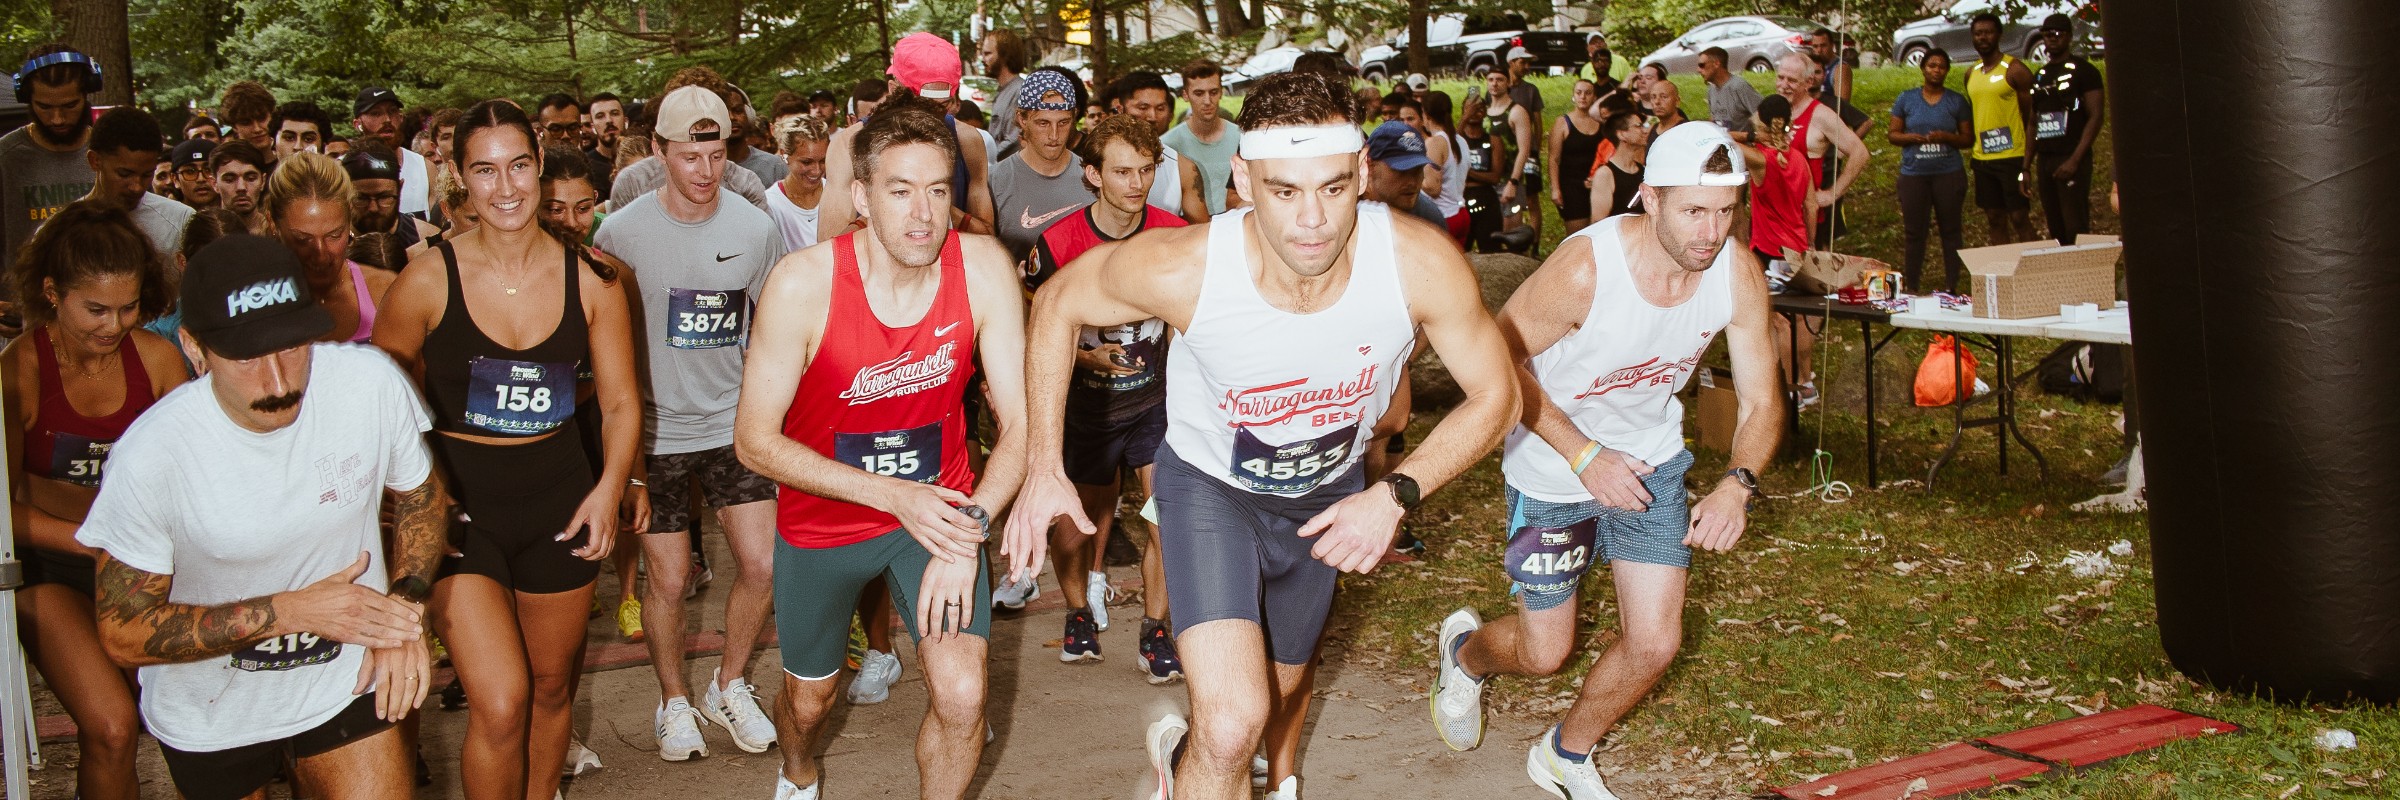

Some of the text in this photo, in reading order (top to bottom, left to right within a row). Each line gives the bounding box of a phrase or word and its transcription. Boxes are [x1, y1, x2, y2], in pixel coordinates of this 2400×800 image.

[227, 280, 298, 317] HOKA
[678, 312, 737, 333] 3874
[839, 341, 956, 406] Narragansett
[896, 375, 948, 397] RUN CLUB
[495, 384, 552, 413] 158
[1218, 363, 1379, 428] Narragansett
[68, 459, 104, 476] 31
[861, 450, 919, 476] 155
[1241, 440, 1349, 480] 4553
[1521, 545, 1585, 575] 4142
